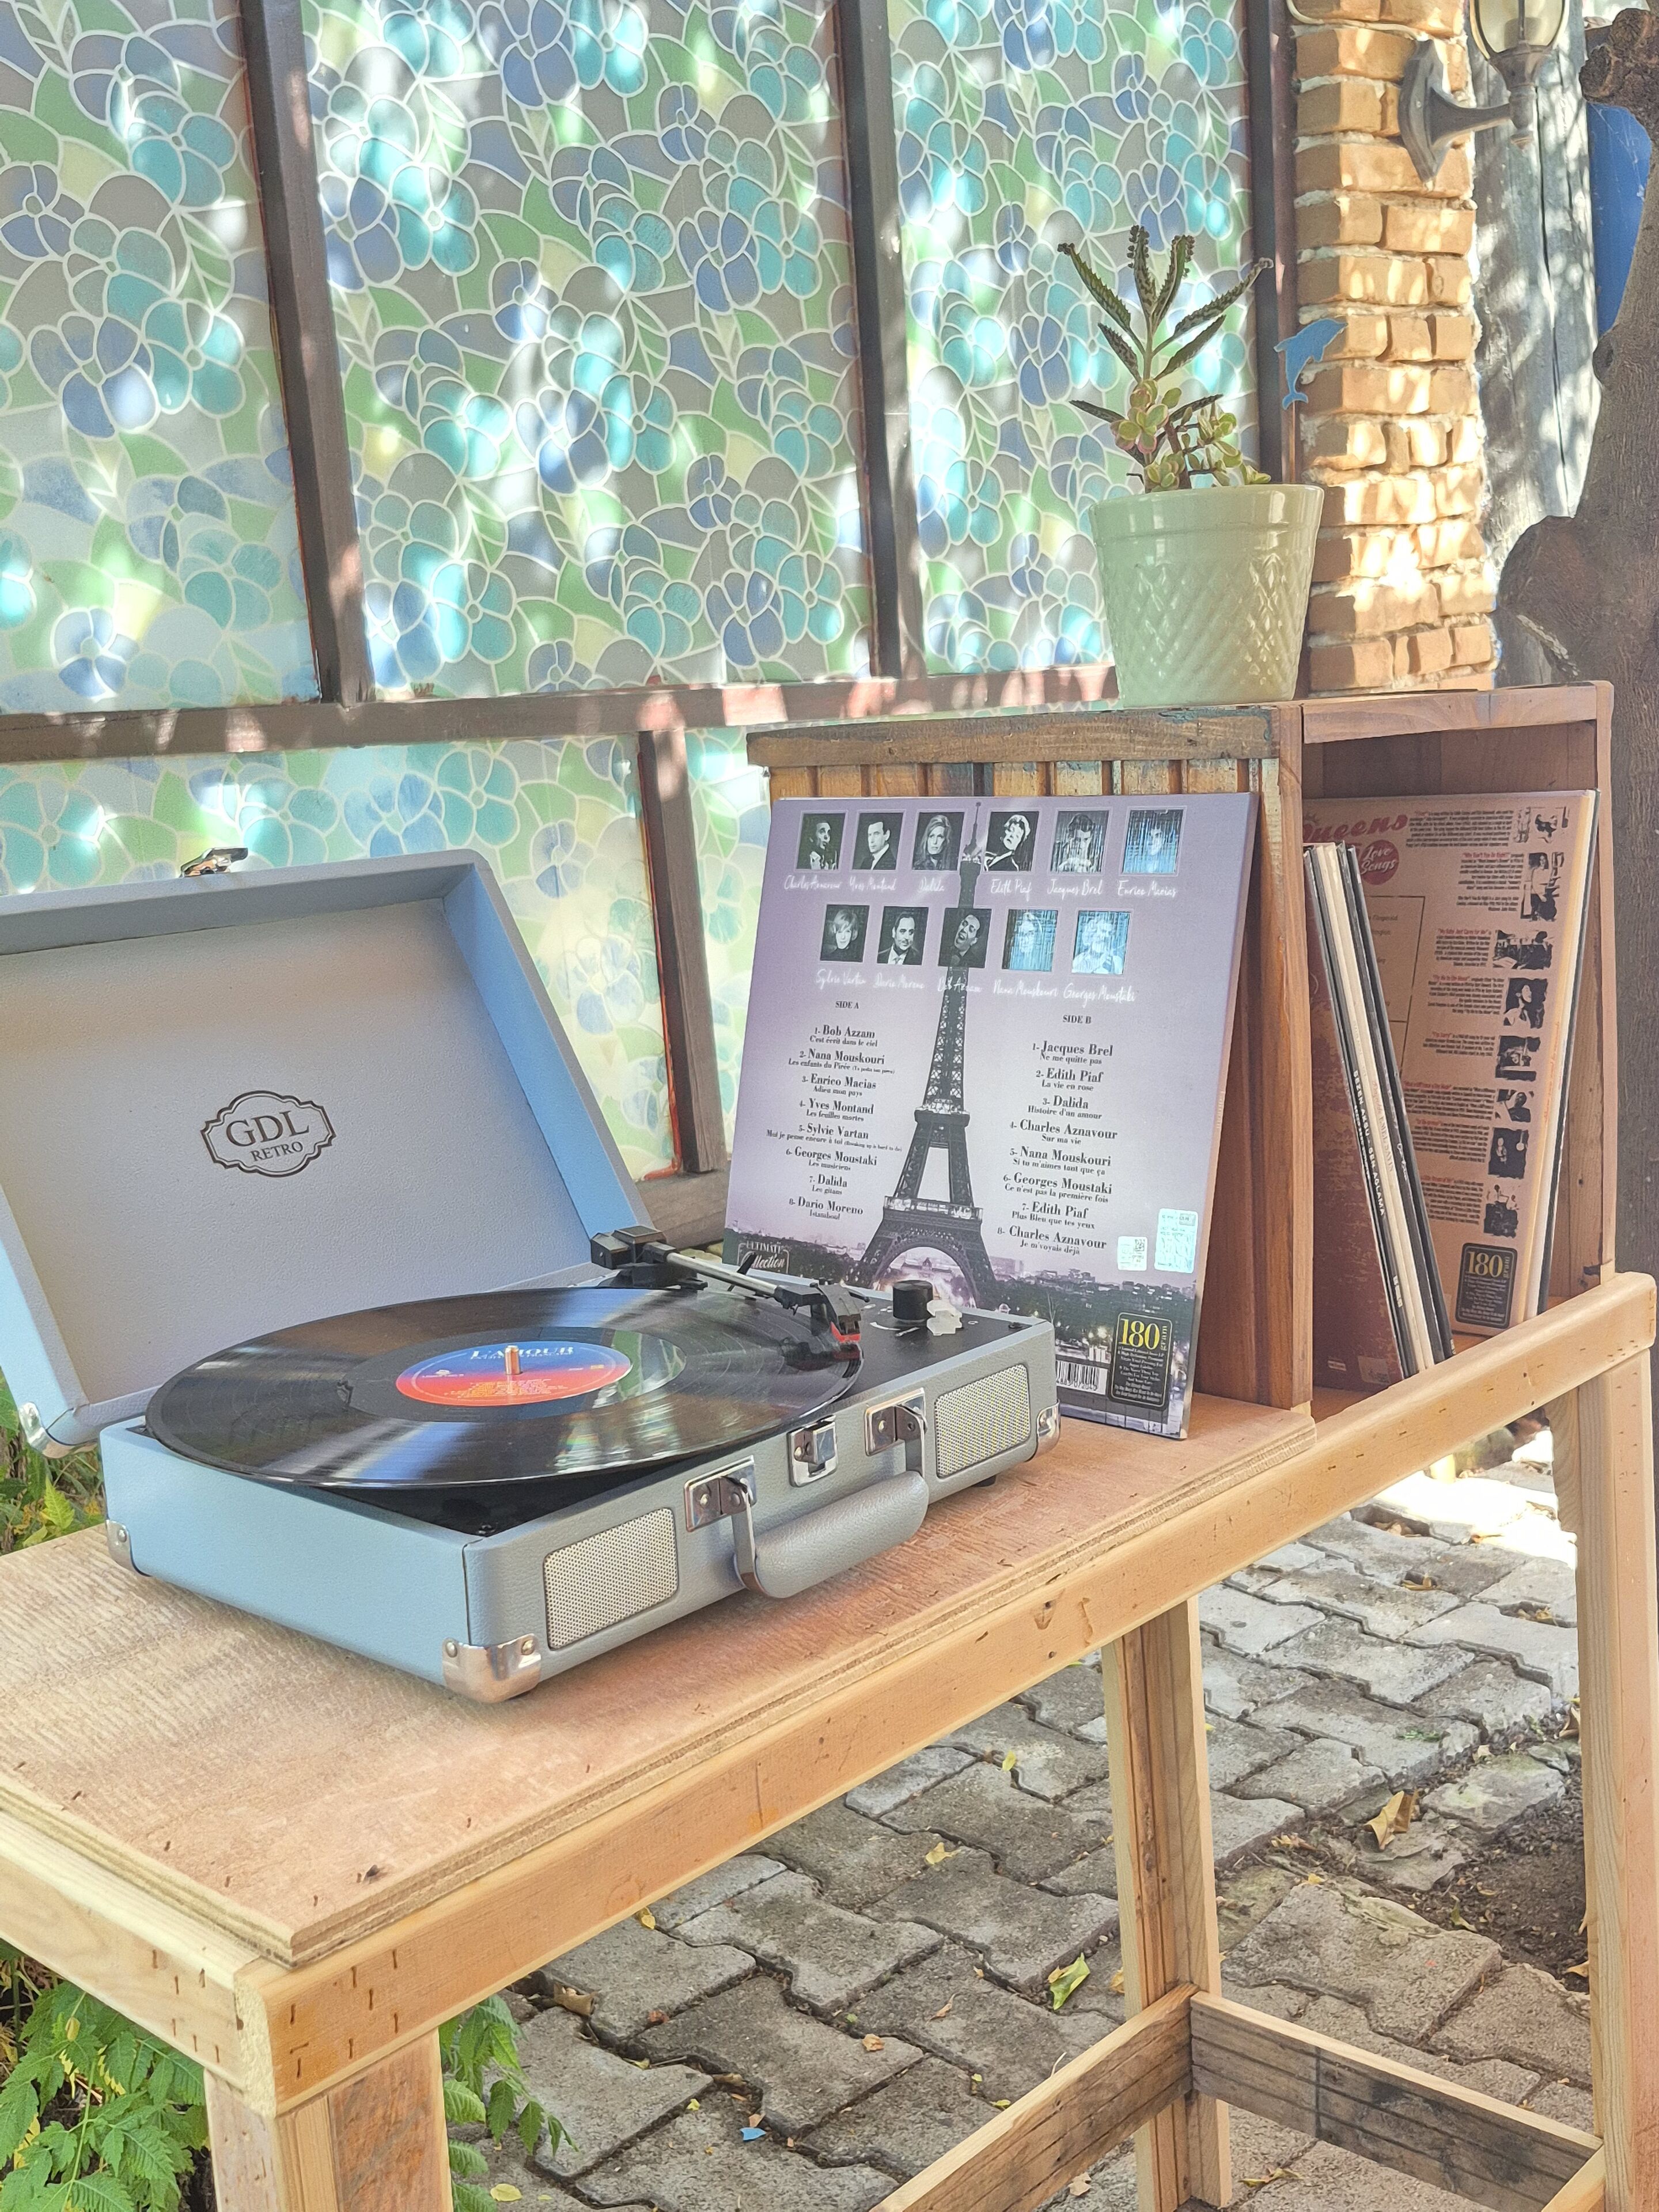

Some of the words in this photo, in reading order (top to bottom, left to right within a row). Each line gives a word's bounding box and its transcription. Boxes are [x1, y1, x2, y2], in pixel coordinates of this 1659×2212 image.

[1363, 846, 1393, 861] Love
[1361, 859, 1396, 874] Songs
[1063, 1014, 1083, 1024] SIDE
[1085, 1016, 1092, 1024] B
[823, 1025, 841, 1036] Bob
[844, 1027, 875, 1038] Azzam
[808, 1048, 831, 1060] Nana
[835, 1050, 885, 1065] Mouskouri
[1041, 1040, 1085, 1056] Jacques
[1089, 1043, 1113, 1056] Brel
[1040, 1052, 1050, 1060] Ne
[1066, 1056, 1087, 1064] quitte
[811, 1074, 841, 1086] Enrico
[844, 1076, 876, 1089] Macias
[1036, 1070, 1044, 1078] 2-
[1046, 1067, 1075, 1081] Edith
[1080, 1070, 1104, 1083] Piaf
[1042, 1080, 1051, 1088] La
[1354, 1071, 1364, 1105] SEZEN
[809, 1098, 830, 1110] Yves
[833, 1100, 874, 1115] Montand
[1053, 1095, 1088, 1109] Dalida
[1028, 1105, 1056, 1116] Histoire
[1059, 1109, 1074, 1117] d'un
[226, 1111, 309, 1147] GDL
[807, 1123, 834, 1136] Sylvie
[838, 1126, 869, 1139] Vartan
[1020, 1119, 1060, 1134] Charles
[1064, 1124, 1118, 1139] Aznavour
[1041, 1134, 1055, 1142] Sur
[251, 1141, 303, 1161] RETRO
[795, 1146, 831, 1162] Georges
[835, 1151, 877, 1166] Moustaki
[1020, 1146, 1047, 1159] Nana
[1051, 1149, 1111, 1166] Mouskouri
[1032, 1160, 1061, 1170] m'aimes
[1081, 1167, 1094, 1175] que
[1097, 1169, 1105, 1177] ça
[818, 1174, 847, 1187] Dalida
[1014, 1172, 1058, 1189] Georges
[1061, 1177, 1112, 1194] Moustaki
[1005, 1183, 1014, 1191] Ce
[1017, 1185, 1032, 1194] n'est
[1050, 1188, 1056, 1196] la
[1059, 1191, 1093, 1201] première
[1095, 1195, 1108, 1203] fois
[798, 1196, 823, 1210] Dario
[828, 1200, 863, 1215] Moreno
[1032, 1201, 1060, 1215] Edith
[1065, 1205, 1089, 1219] Piaf
[1012, 1211, 1027, 1219] Plus
[1030, 1213, 1046, 1222] Bleu
[1077, 1221, 1095, 1229] yeux
[1009, 1225, 1050, 1241] Charles
[1053, 1232, 1107, 1249] Aznavour
[1020, 1239, 1028, 1247] Je
[1065, 1245, 1080, 1256] déjà
[740, 1251, 785, 1268] Cllection
[1465, 1252, 1503, 1278] 180
[1119, 1319, 1160, 1350] 180
